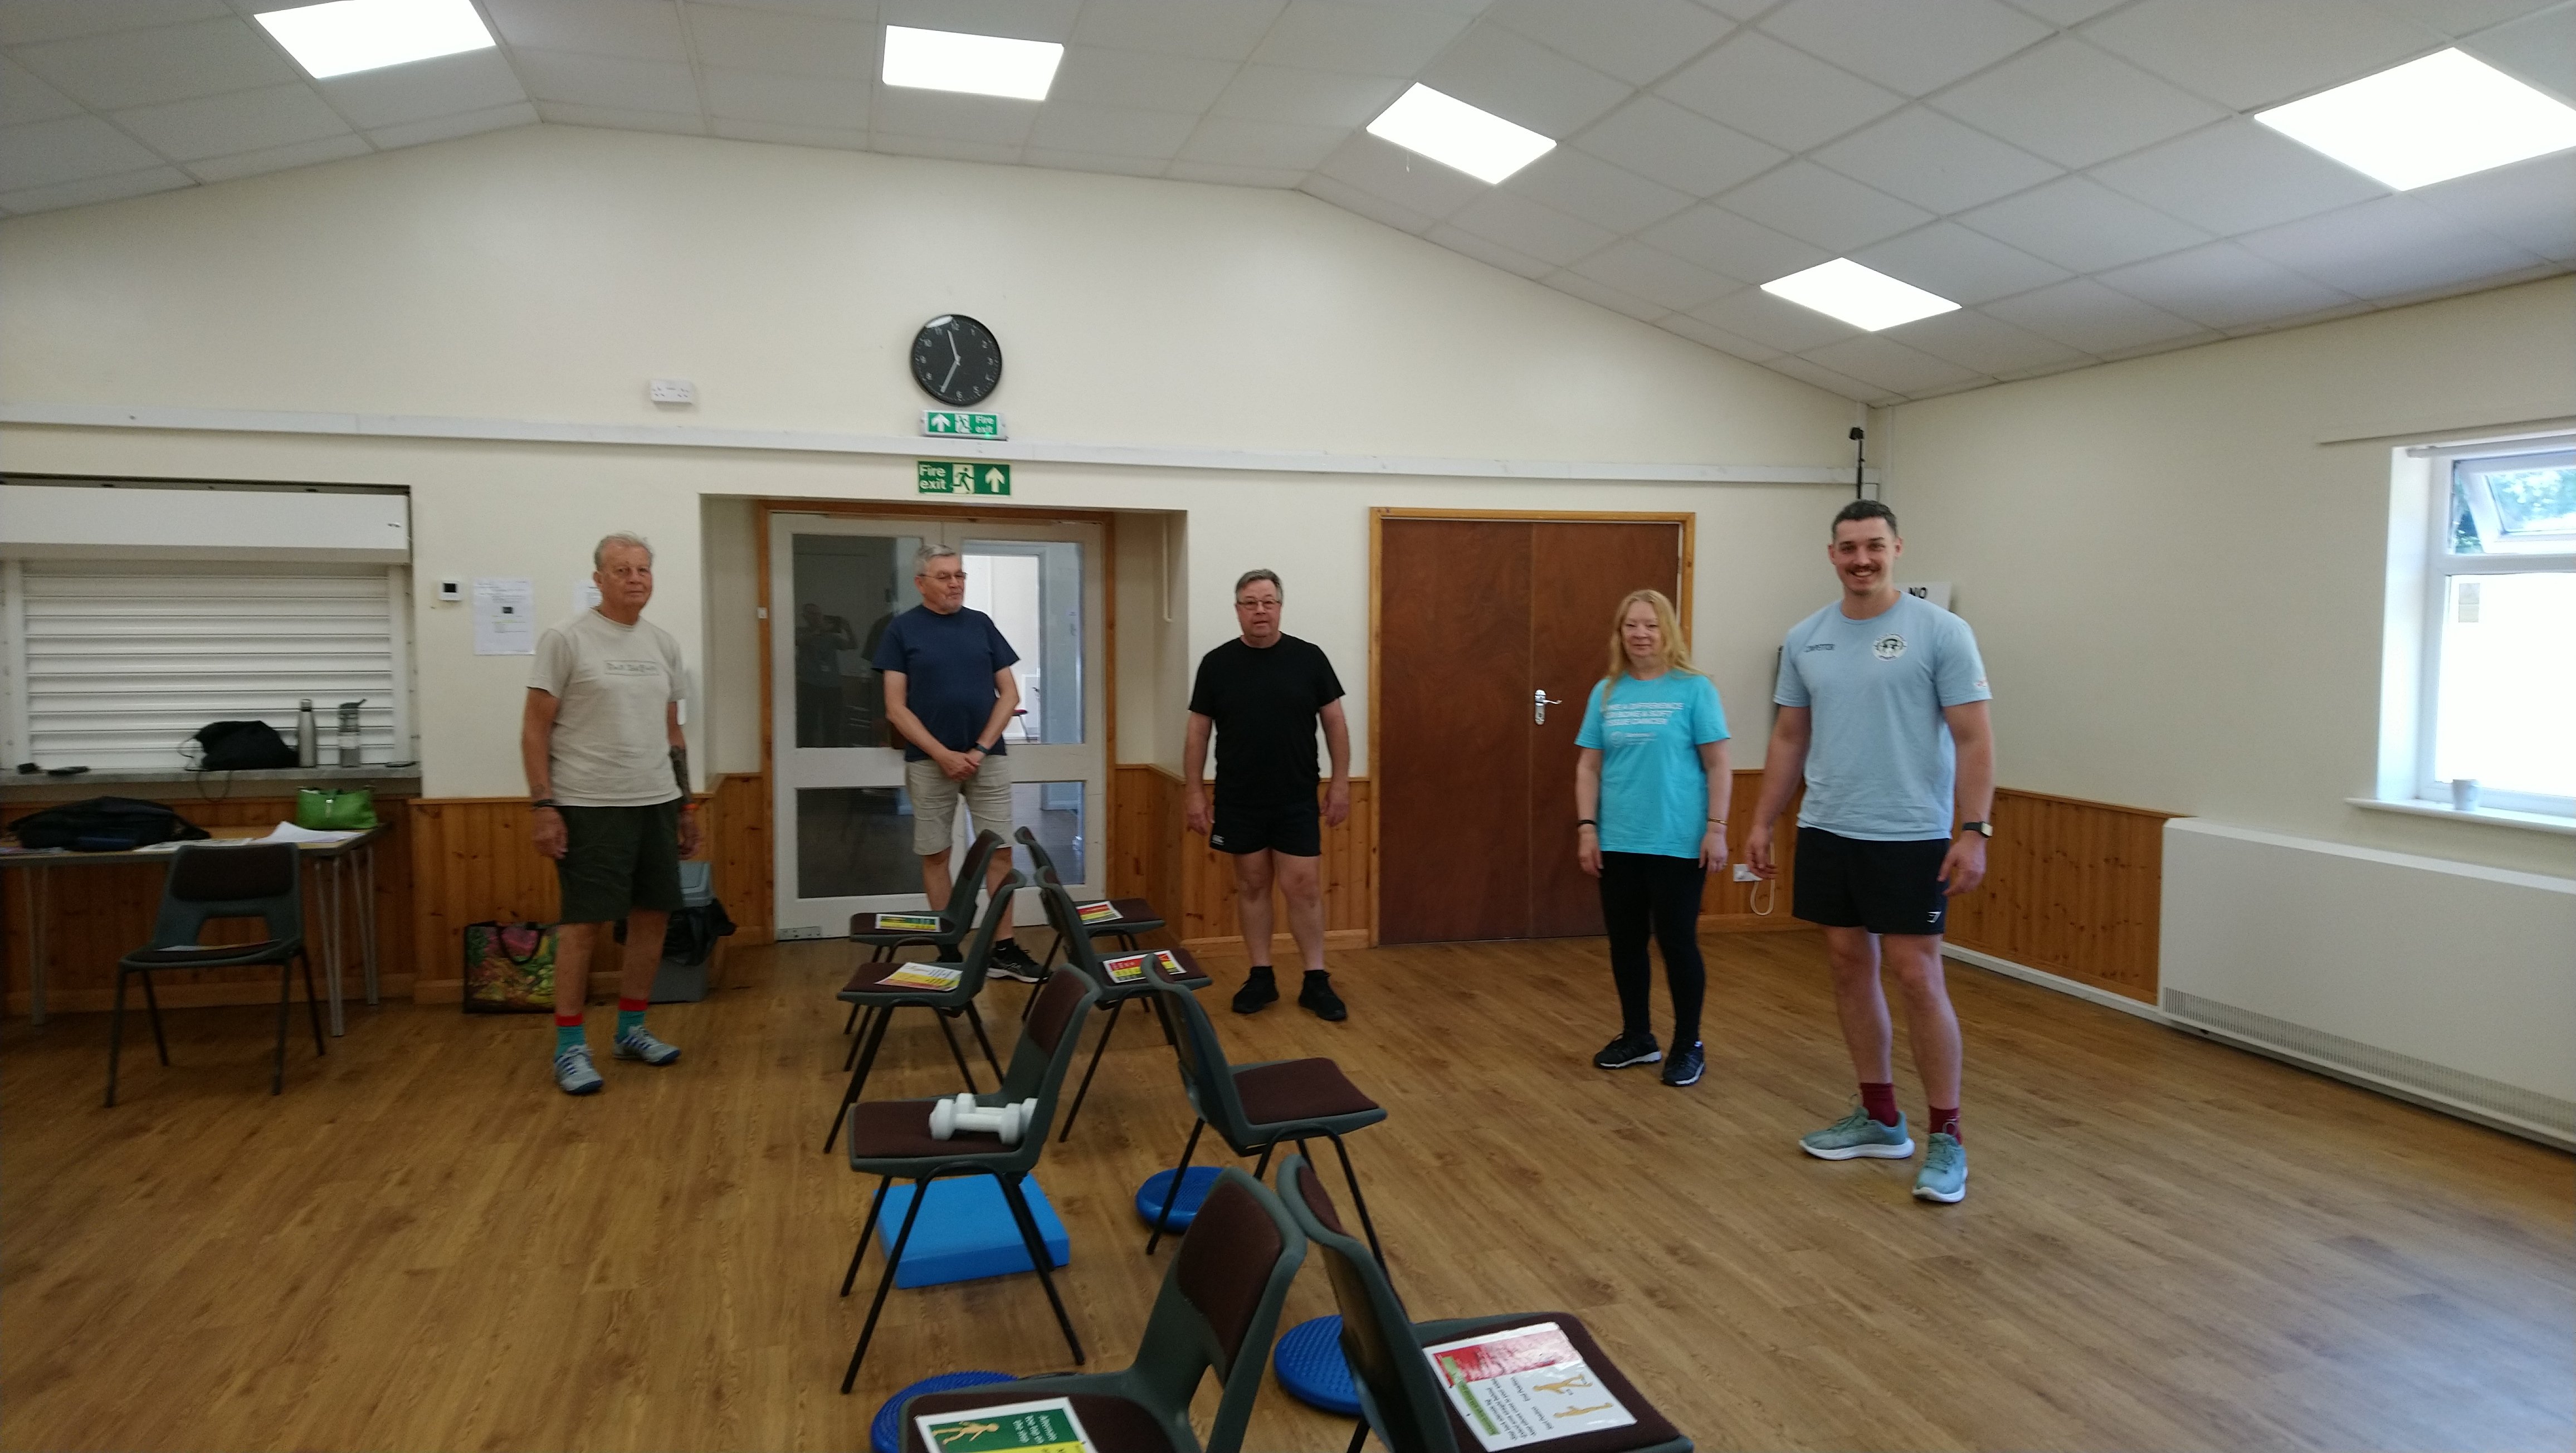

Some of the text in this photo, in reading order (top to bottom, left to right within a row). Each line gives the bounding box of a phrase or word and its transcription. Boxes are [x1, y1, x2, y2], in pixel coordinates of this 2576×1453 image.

[975, 415, 994, 425] Fire
[920, 465, 946, 477] Fire
[920, 478, 947, 490] exit
[1909, 587, 1927, 598] NO
